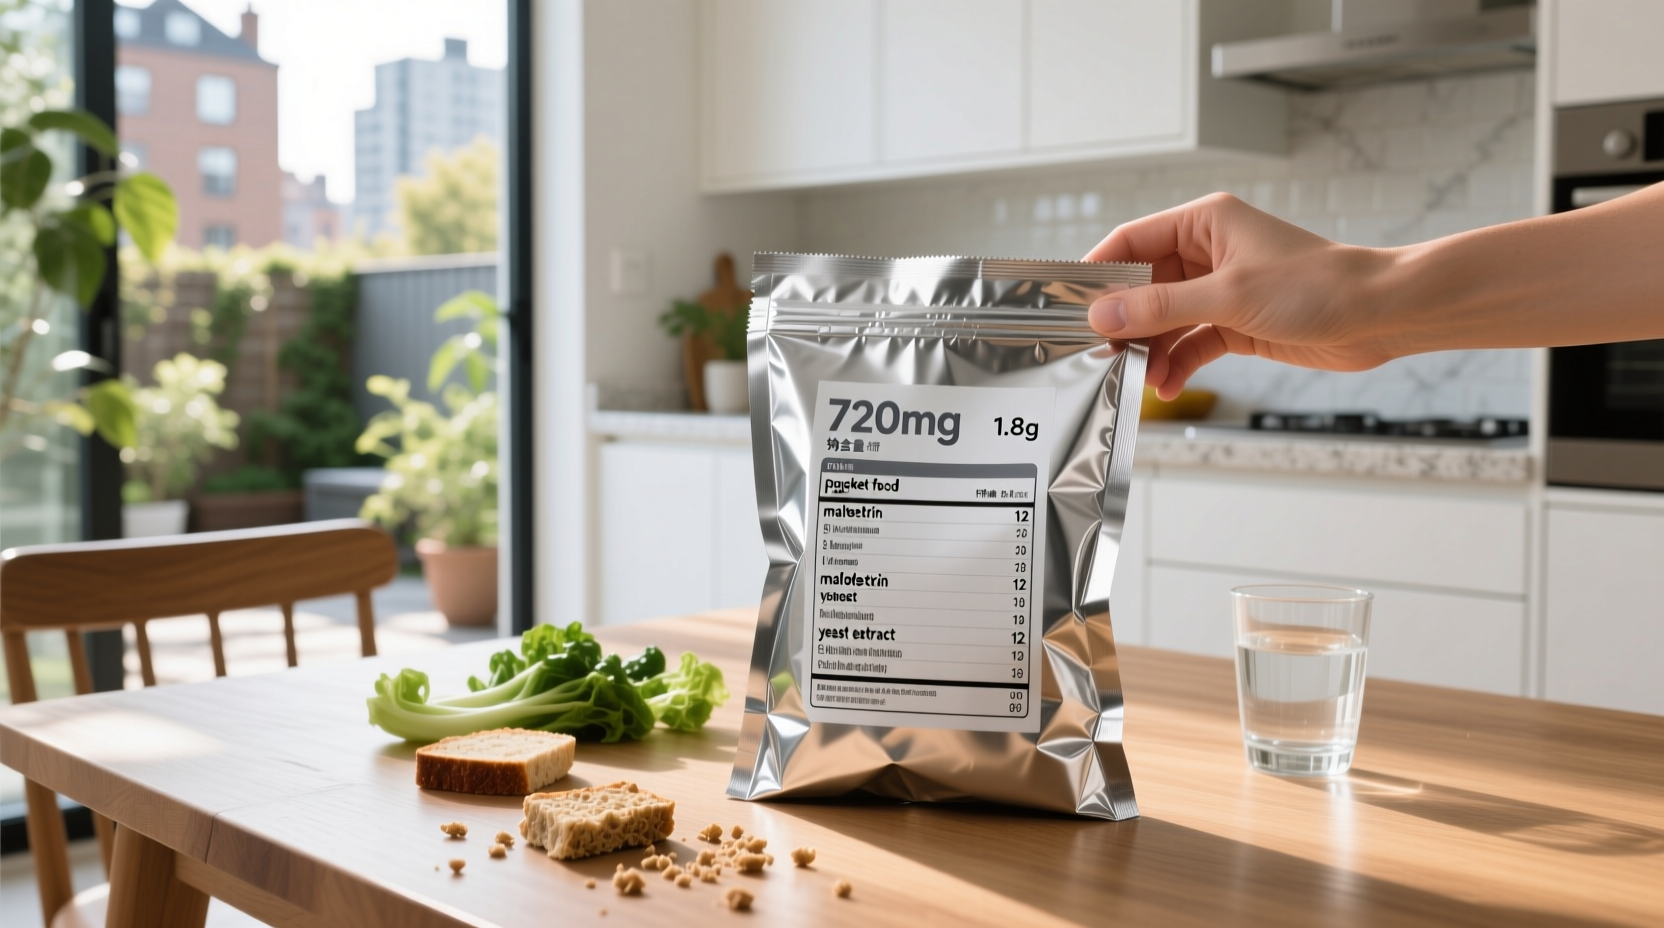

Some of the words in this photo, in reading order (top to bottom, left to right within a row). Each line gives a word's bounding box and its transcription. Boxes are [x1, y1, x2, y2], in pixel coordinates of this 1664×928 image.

[828, 398, 961, 446] 720mg
[994, 417, 1039, 441] 1.8g
[872, 478, 900, 492] food
[1015, 510, 1029, 522] 12
[1012, 578, 1027, 591] 12
[1011, 631, 1026, 645] 12
